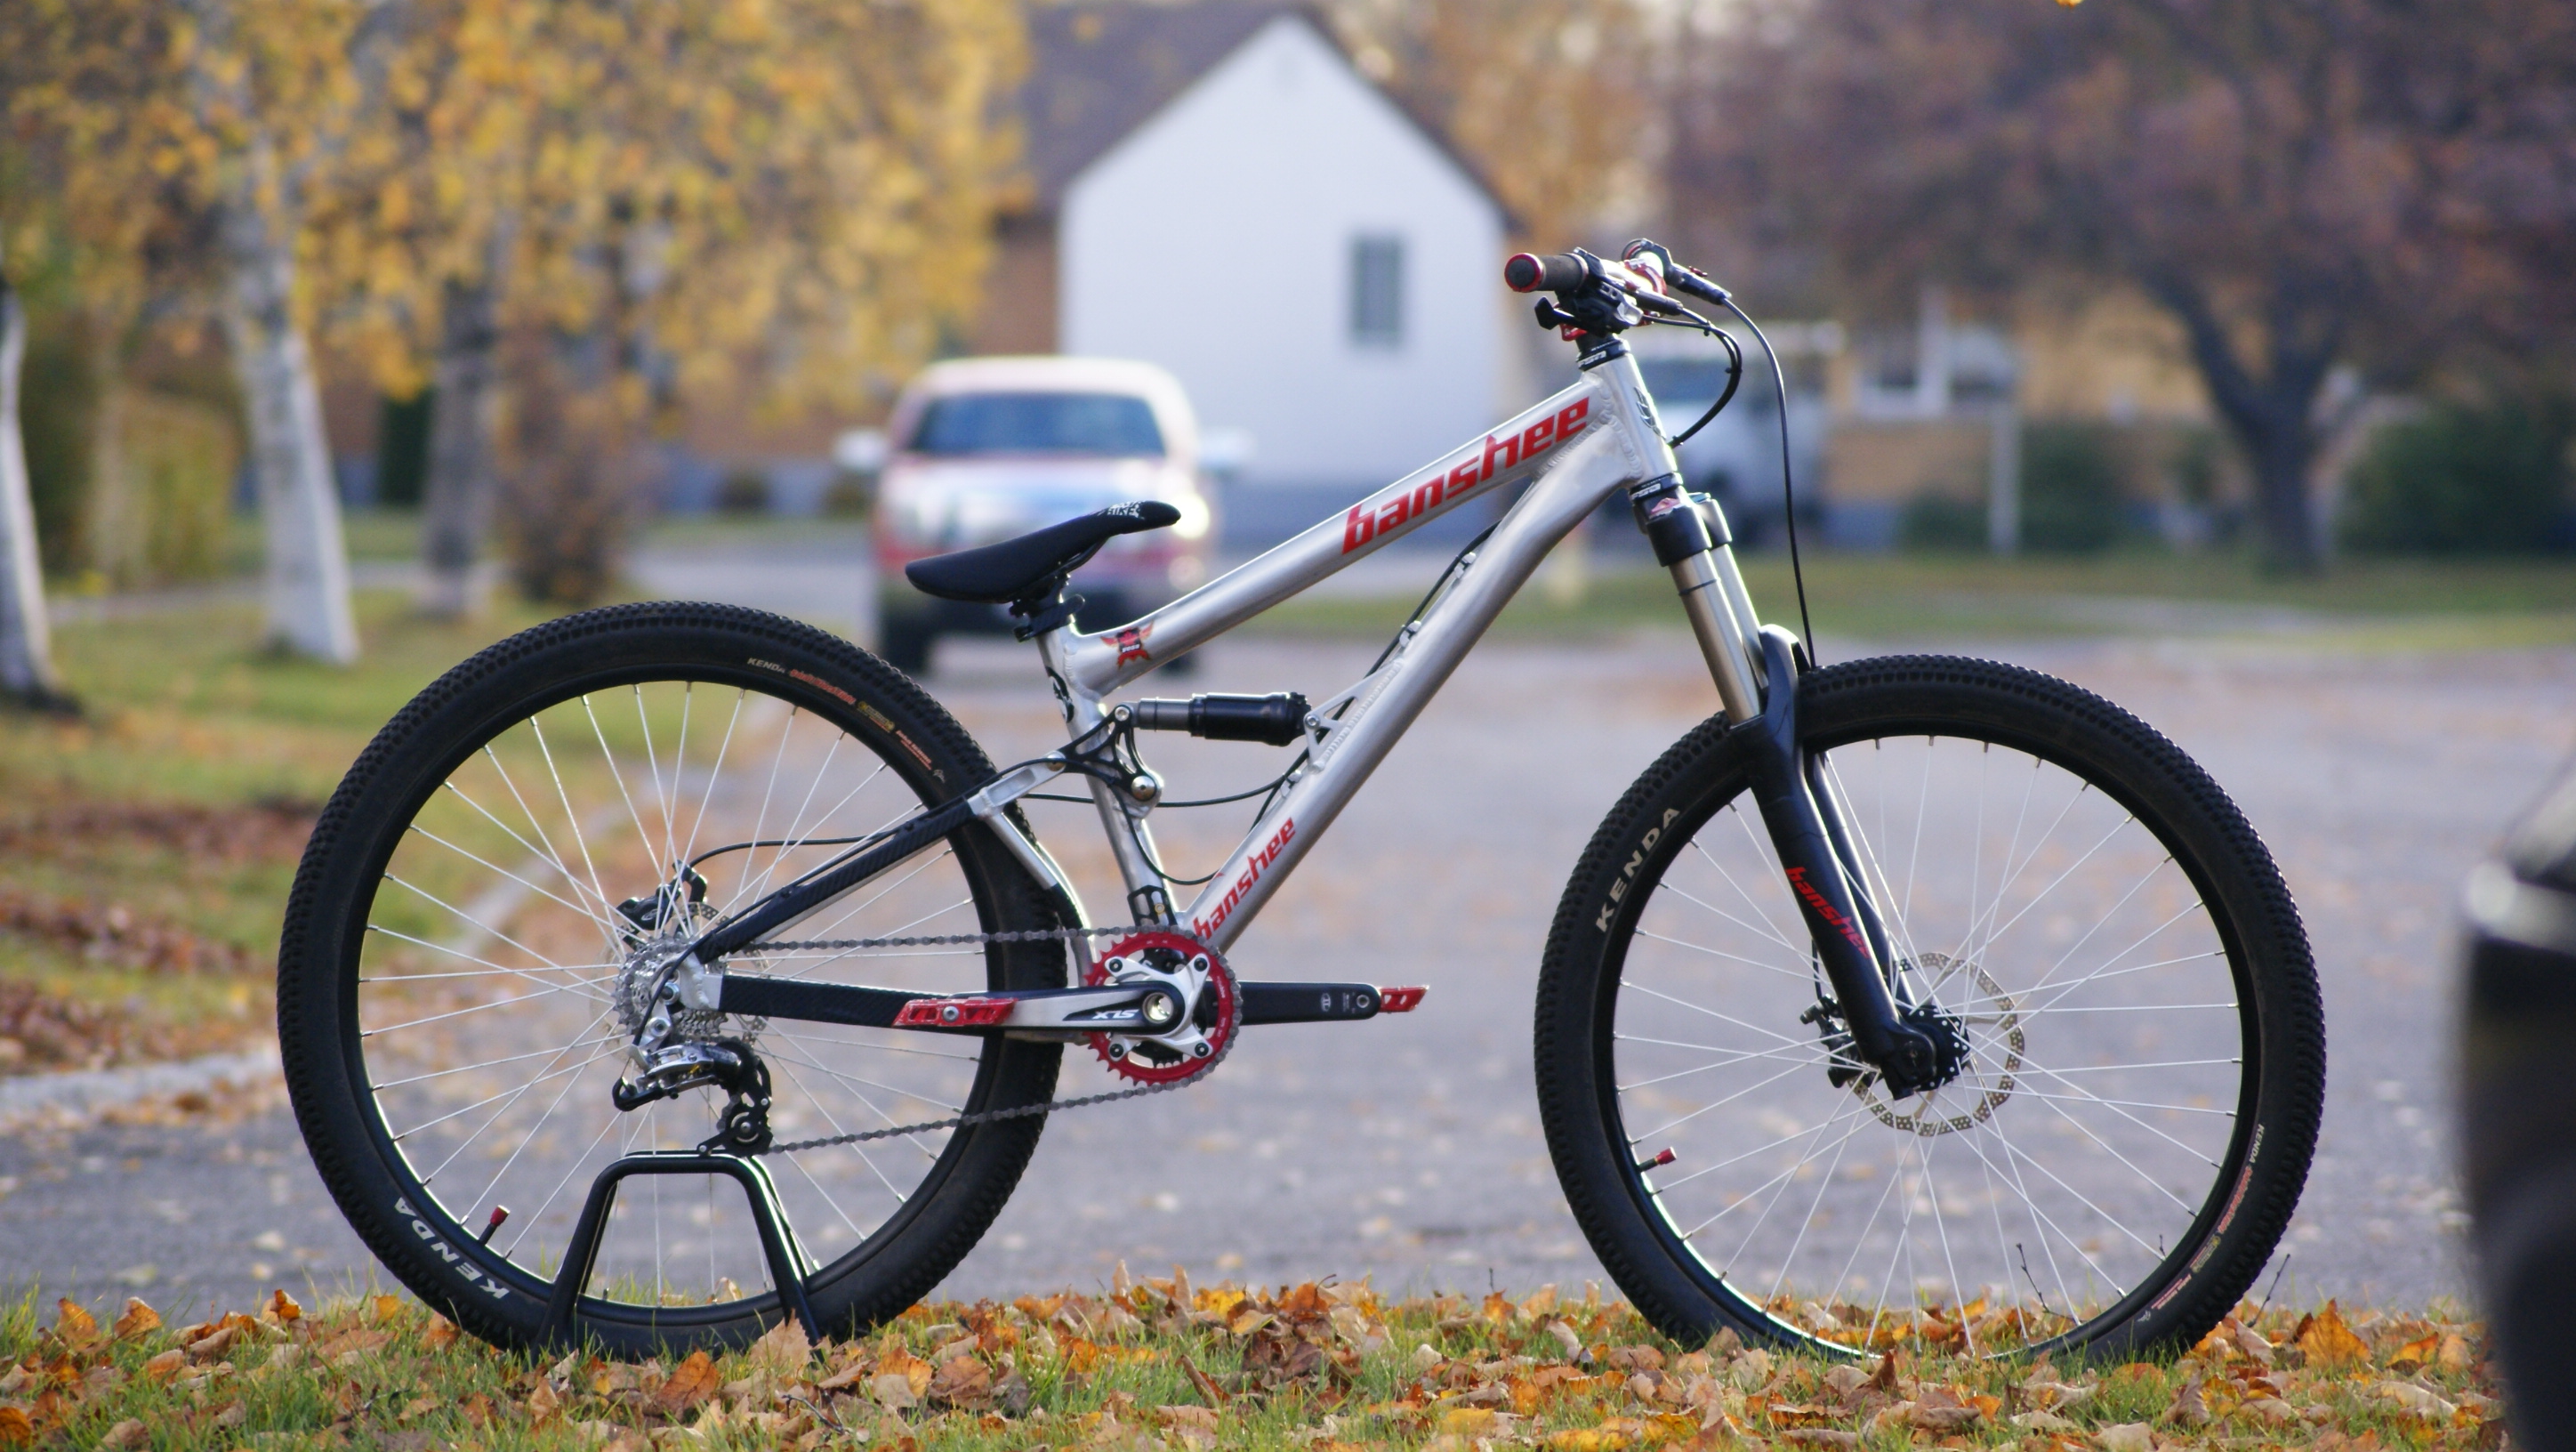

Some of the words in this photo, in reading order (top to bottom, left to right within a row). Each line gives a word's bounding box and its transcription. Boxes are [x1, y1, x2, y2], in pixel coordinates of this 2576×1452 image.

[1342, 397, 1590, 554] banshee
[747, 657, 785, 674] KENDA
[1596, 808, 1680, 932] KENDA
[1092, 1009, 1139, 1020] SLX
[2249, 1124, 2265, 1164] KENDA
[394, 1197, 510, 1299] KENDA
